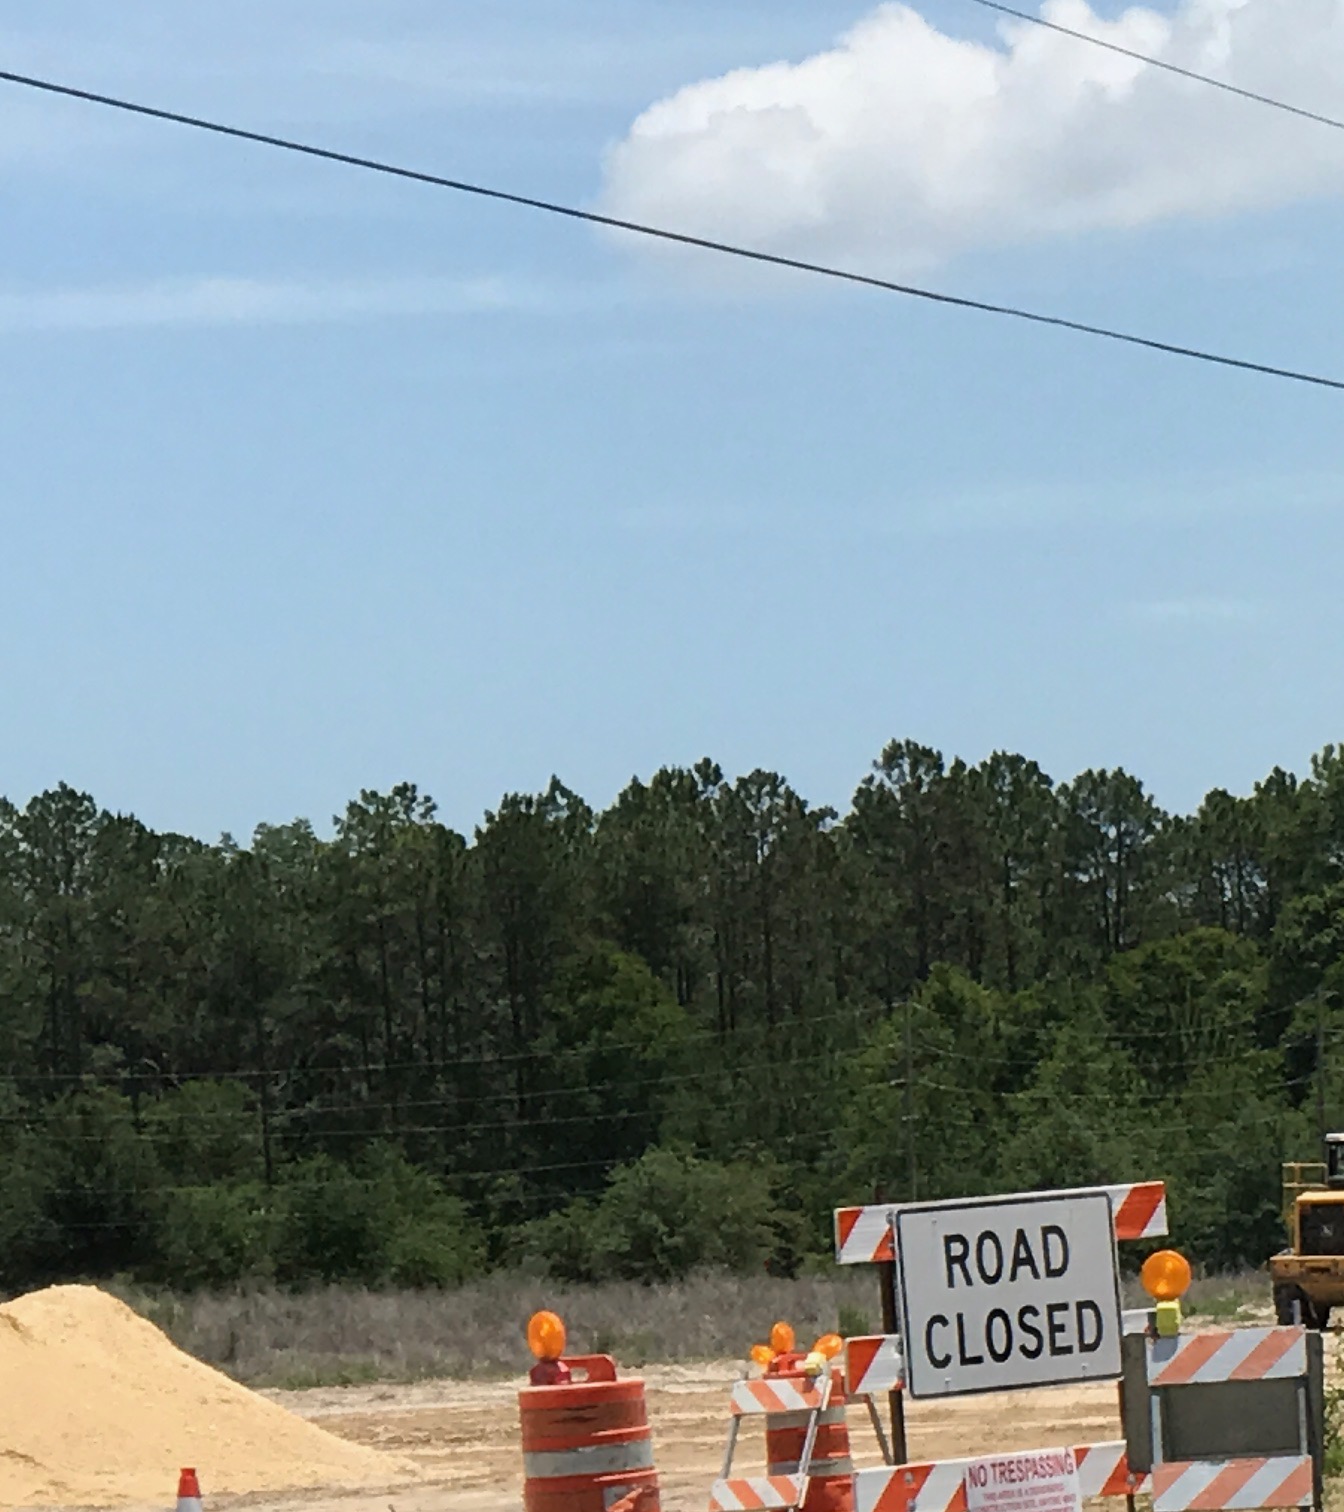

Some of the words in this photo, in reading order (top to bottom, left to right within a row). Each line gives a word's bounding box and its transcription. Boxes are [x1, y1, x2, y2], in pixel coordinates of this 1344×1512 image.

[943, 1225, 1069, 1288] ROAD
[925, 1300, 1103, 1369] CLOSED
[968, 1464, 988, 1488] NO
[990, 1453, 1074, 1484] TRESPASSING
